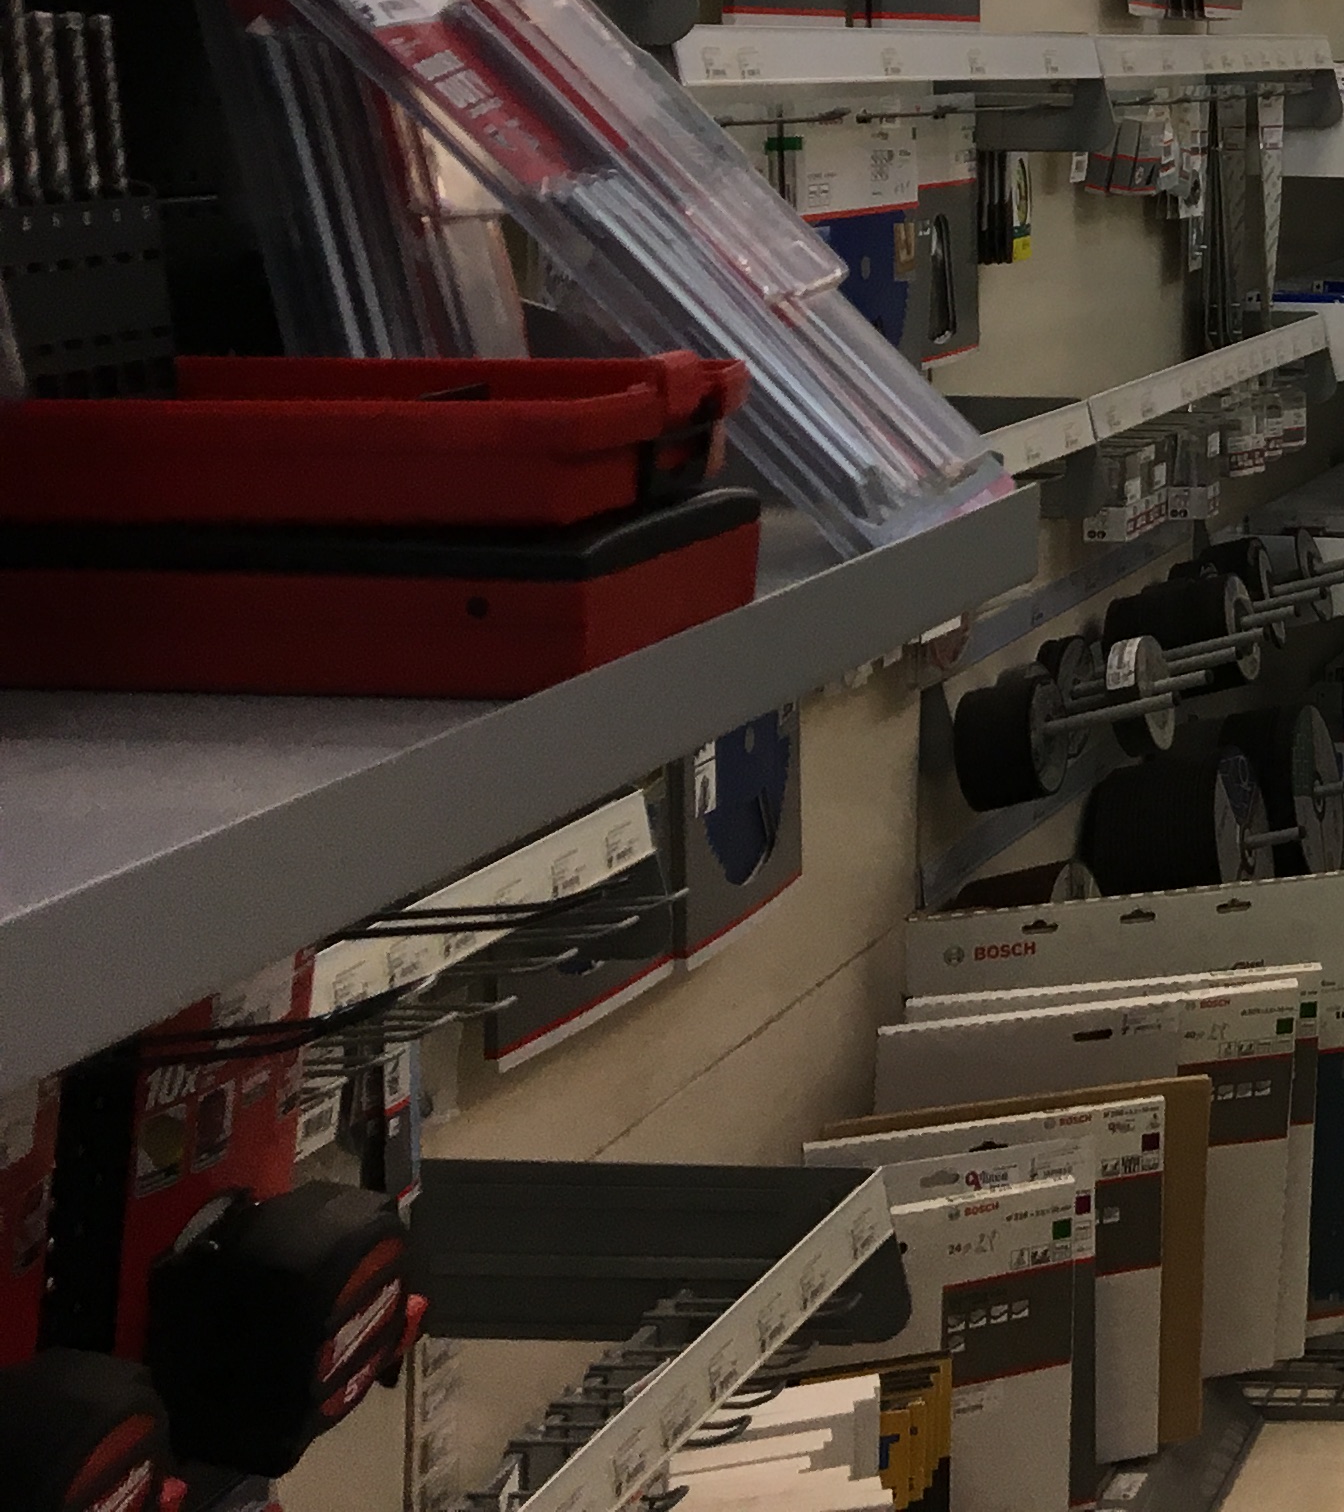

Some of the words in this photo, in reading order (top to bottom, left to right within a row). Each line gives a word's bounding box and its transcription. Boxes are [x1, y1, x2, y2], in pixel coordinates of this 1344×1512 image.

[974, 941, 1036, 962] BOSCH
[1059, 1114, 1092, 1127] BOSCH
[964, 1200, 1000, 1217] BOSCH
